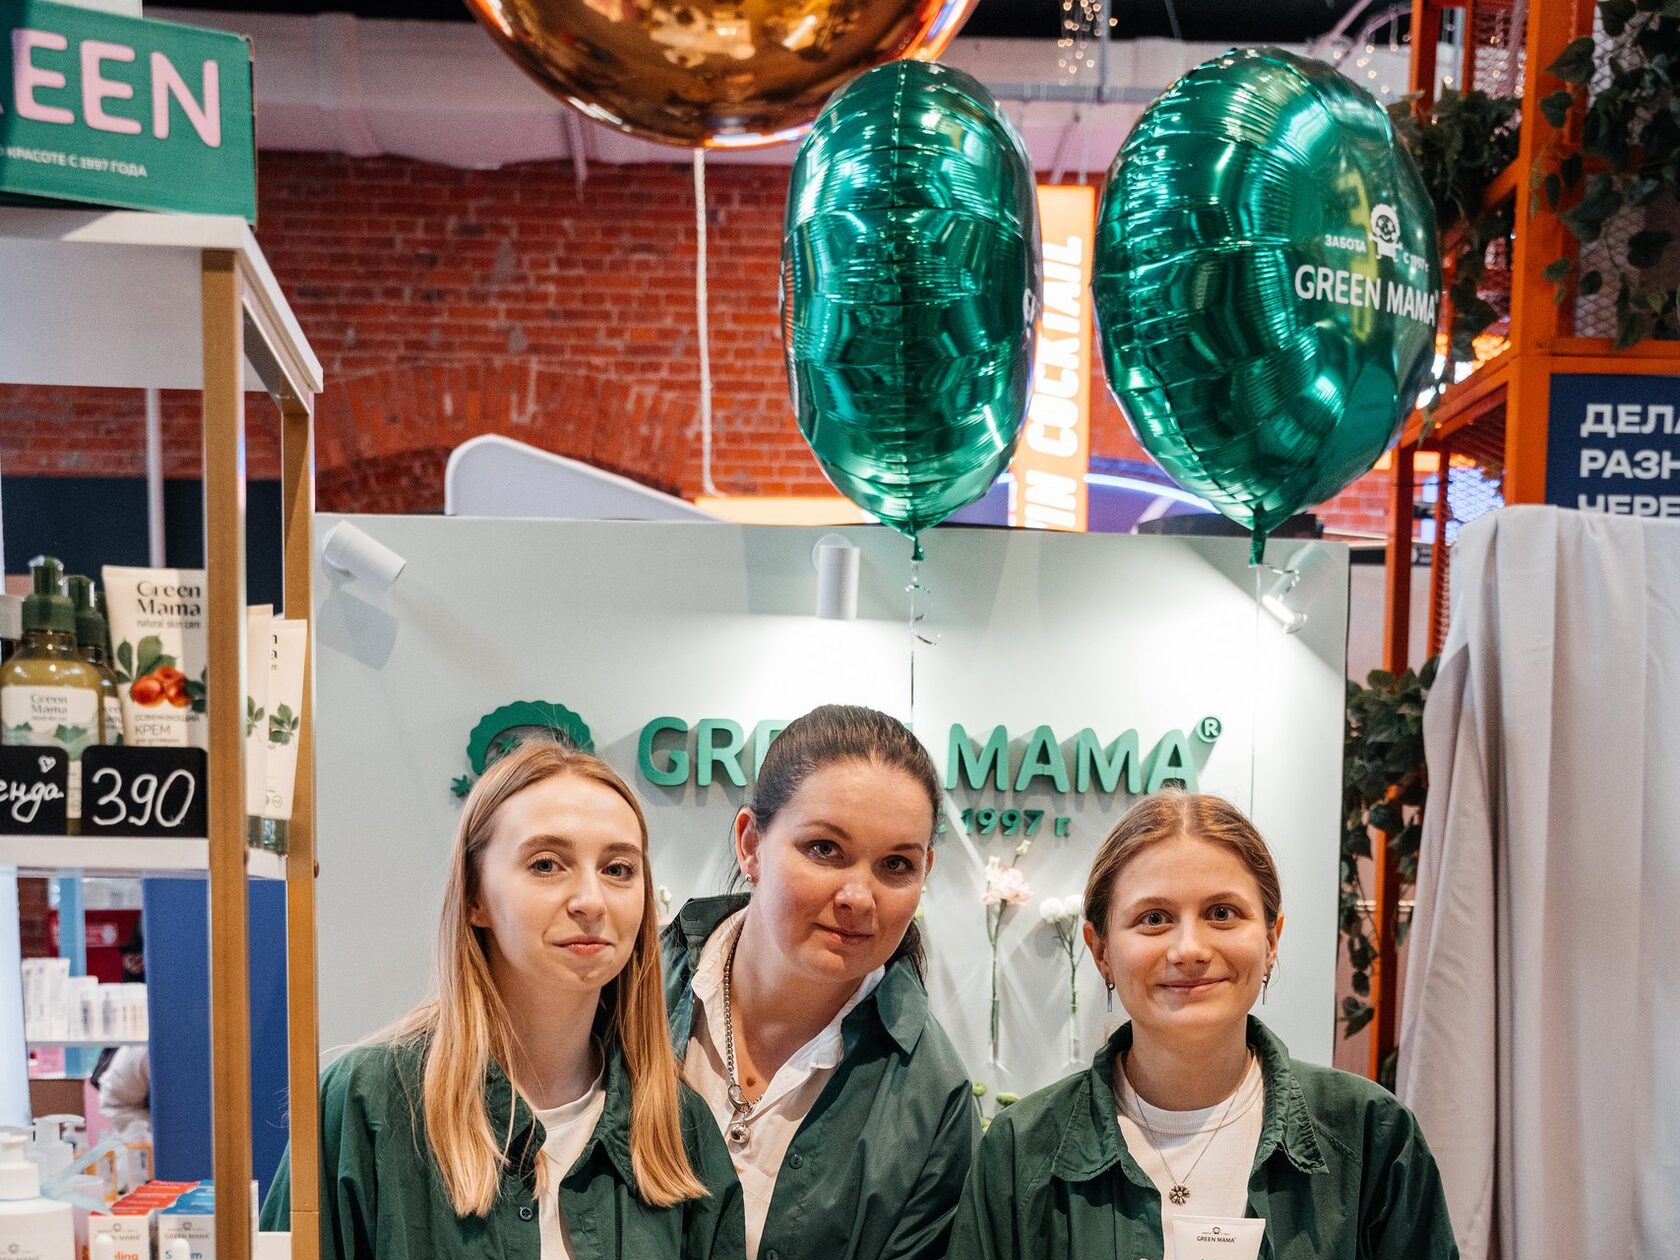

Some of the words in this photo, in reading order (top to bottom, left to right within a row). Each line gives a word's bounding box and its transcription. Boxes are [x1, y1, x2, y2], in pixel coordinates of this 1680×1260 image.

[0, 28, 221, 148] EEN
[7, 146, 66, 166] КРАСОТЕ
[80, 157, 109, 171] 1997
[111, 161, 147, 177] ГОДА
[1325, 234, 1366, 252] ЗАБОТА
[1295, 265, 1381, 310] GREEN
[1387, 281, 1435, 327] MAMA
[1580, 403, 1680, 438] ДЕЛ
[137, 581, 201, 599] Green
[137, 599, 201, 617] Mama
[944, 723, 1200, 796] MAMA
[91, 767, 195, 828] 390
[961, 808, 1045, 836] 1997
